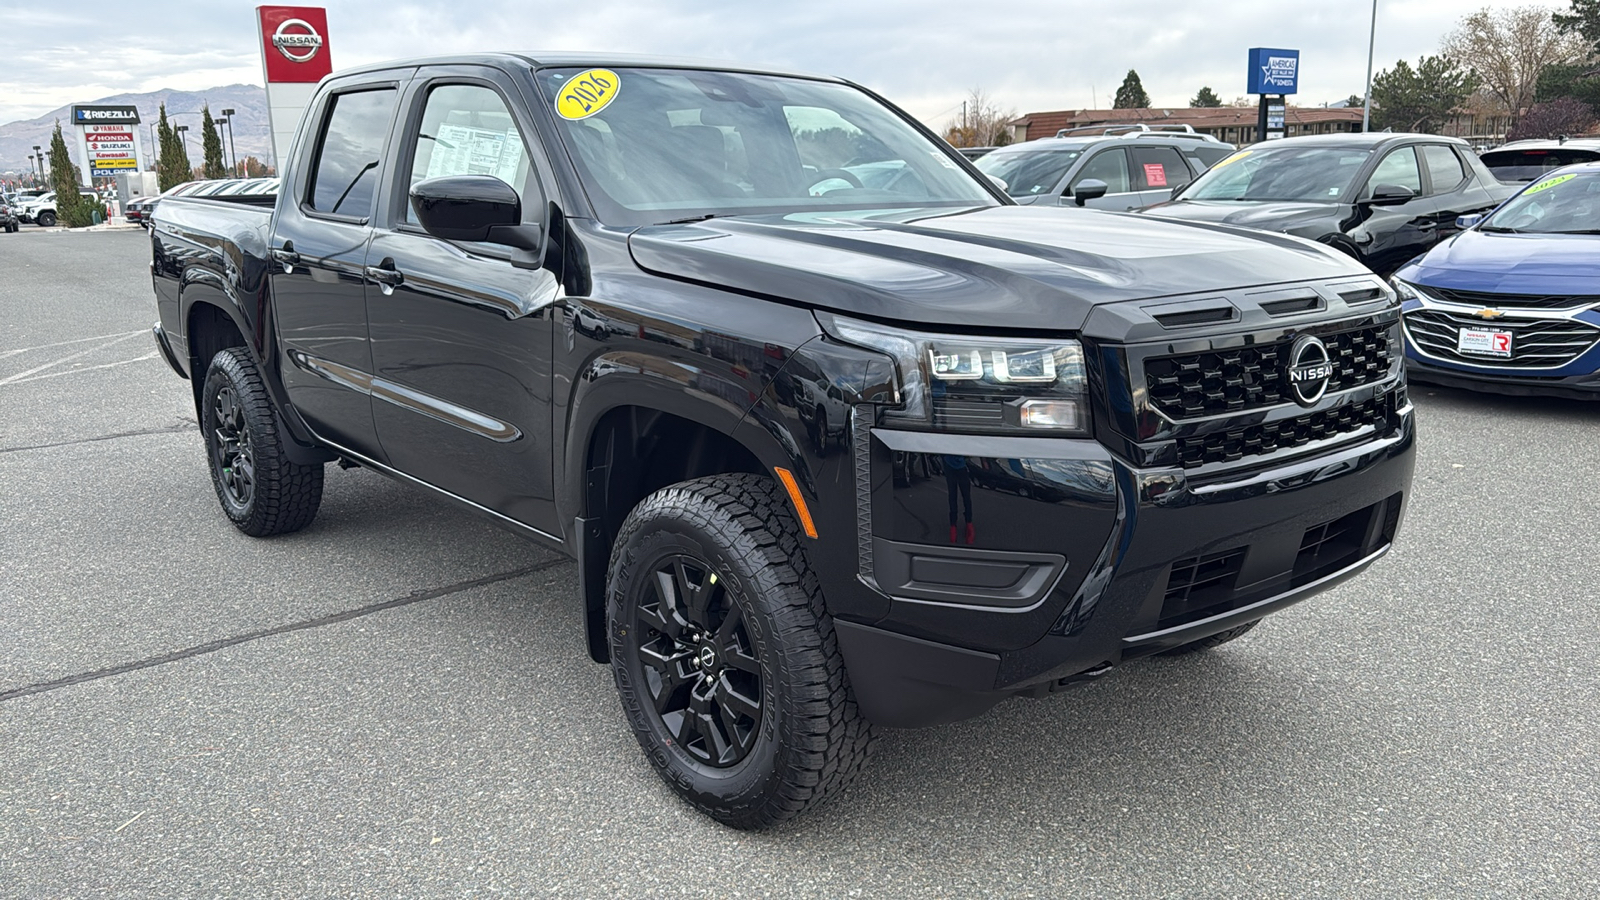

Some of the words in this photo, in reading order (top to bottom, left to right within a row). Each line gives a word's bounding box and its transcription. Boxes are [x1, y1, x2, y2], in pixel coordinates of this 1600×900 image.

[277, 36, 318, 44] NISSAN
[1271, 60, 1295, 69] AMERICAS
[565, 72, 611, 113] 2026
[92, 110, 136, 119] RIDEZILLA
